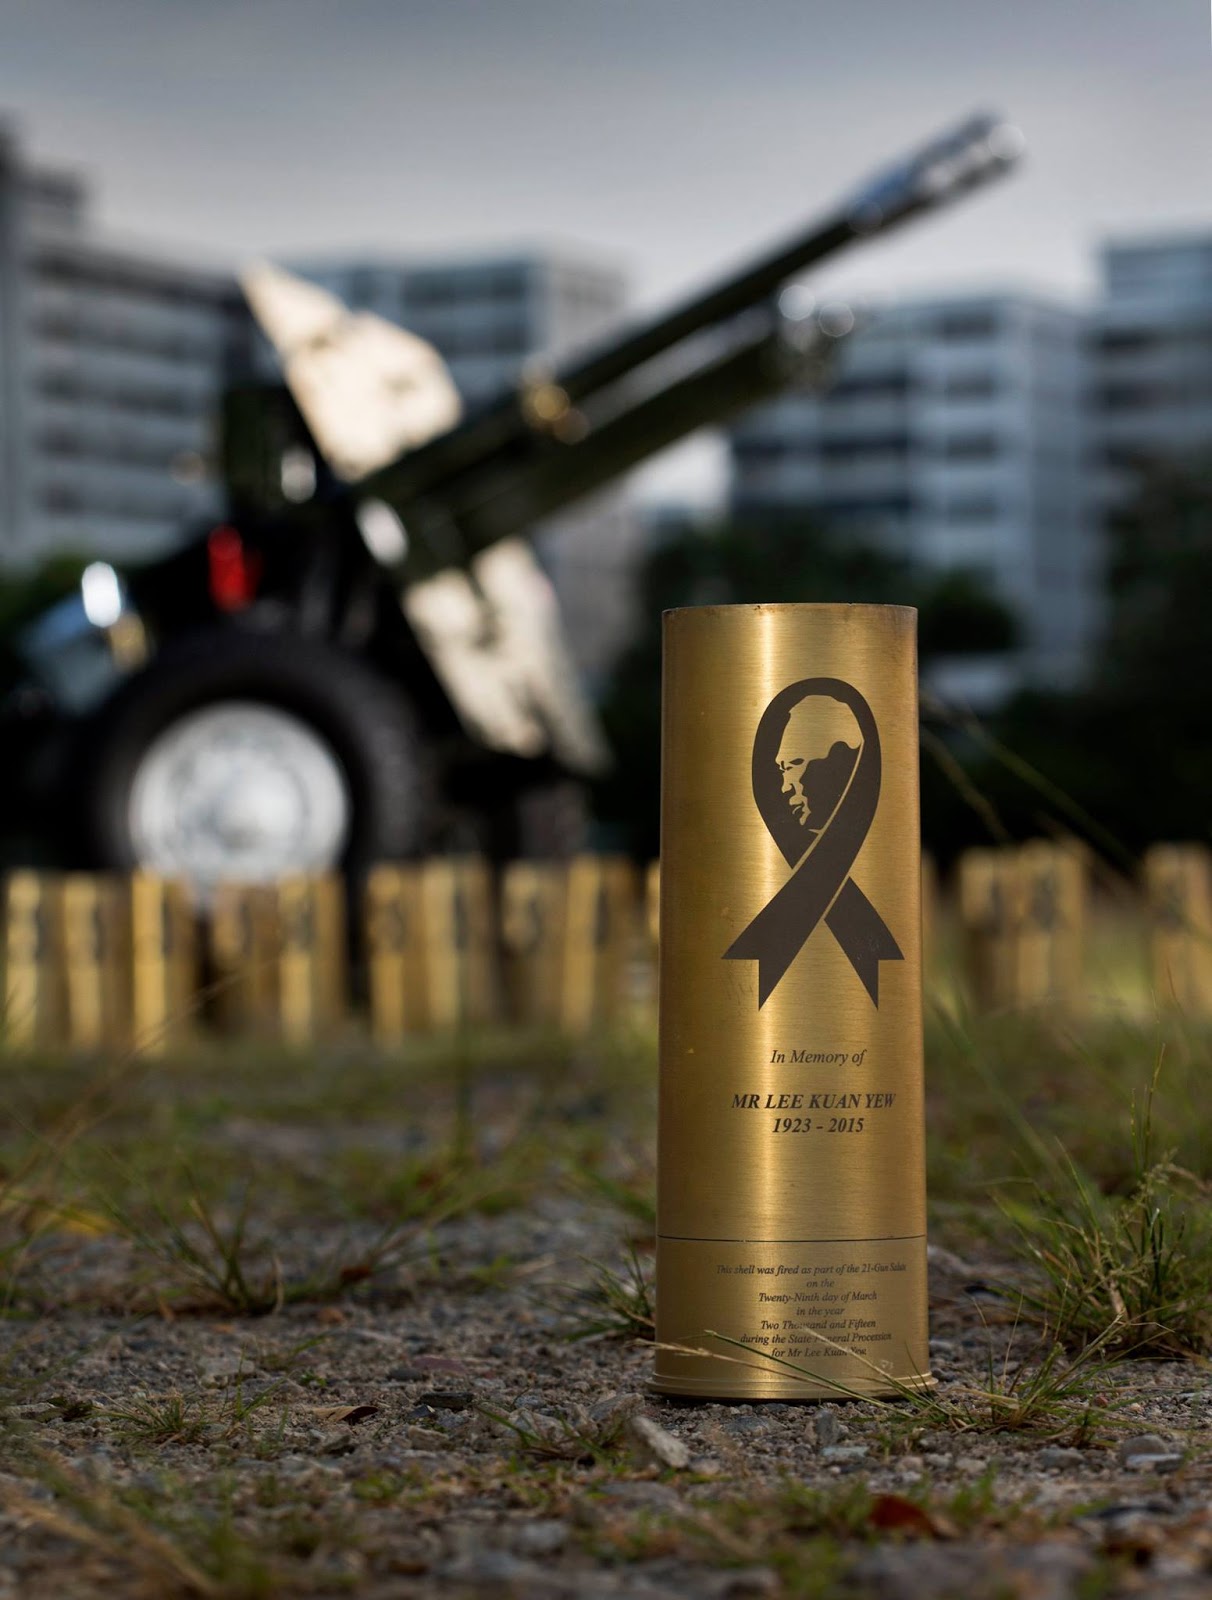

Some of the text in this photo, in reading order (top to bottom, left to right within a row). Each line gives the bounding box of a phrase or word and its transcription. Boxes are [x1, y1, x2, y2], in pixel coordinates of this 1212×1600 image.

[770, 1049, 867, 1067] In Memory of
[731, 1093, 896, 1109] MR LEE KUAN YEW
[772, 1118, 812, 1133] 1923
[827, 1117, 864, 1133] 2015
[716, 1264, 732, 1274] This
[734, 1264, 755, 1274] shell
[775, 1264, 800, 1276] fired
[813, 1265, 834, 1276] part
[835, 1263, 846, 1275] of
[846, 1263, 859, 1273] the
[861, 1263, 889, 1273] 21-Gun
[820, 1279, 835, 1288] the
[759, 1290, 877, 1304] Twenty-Ninth day of March
[796, 1306, 845, 1318] in the year
[760, 1320, 779, 1330] Two
[829, 1319, 847, 1329] and
[848, 1318, 876, 1330] Fifteen
[740, 1333, 769, 1345] during
[771, 1334, 786, 1344] the
[788, 1334, 812, 1344] State
[852, 1332, 892, 1342] Procession
[771, 1347, 786, 1358] for
[788, 1347, 803, 1357] Mr
[804, 1347, 820, 1357] Lee
